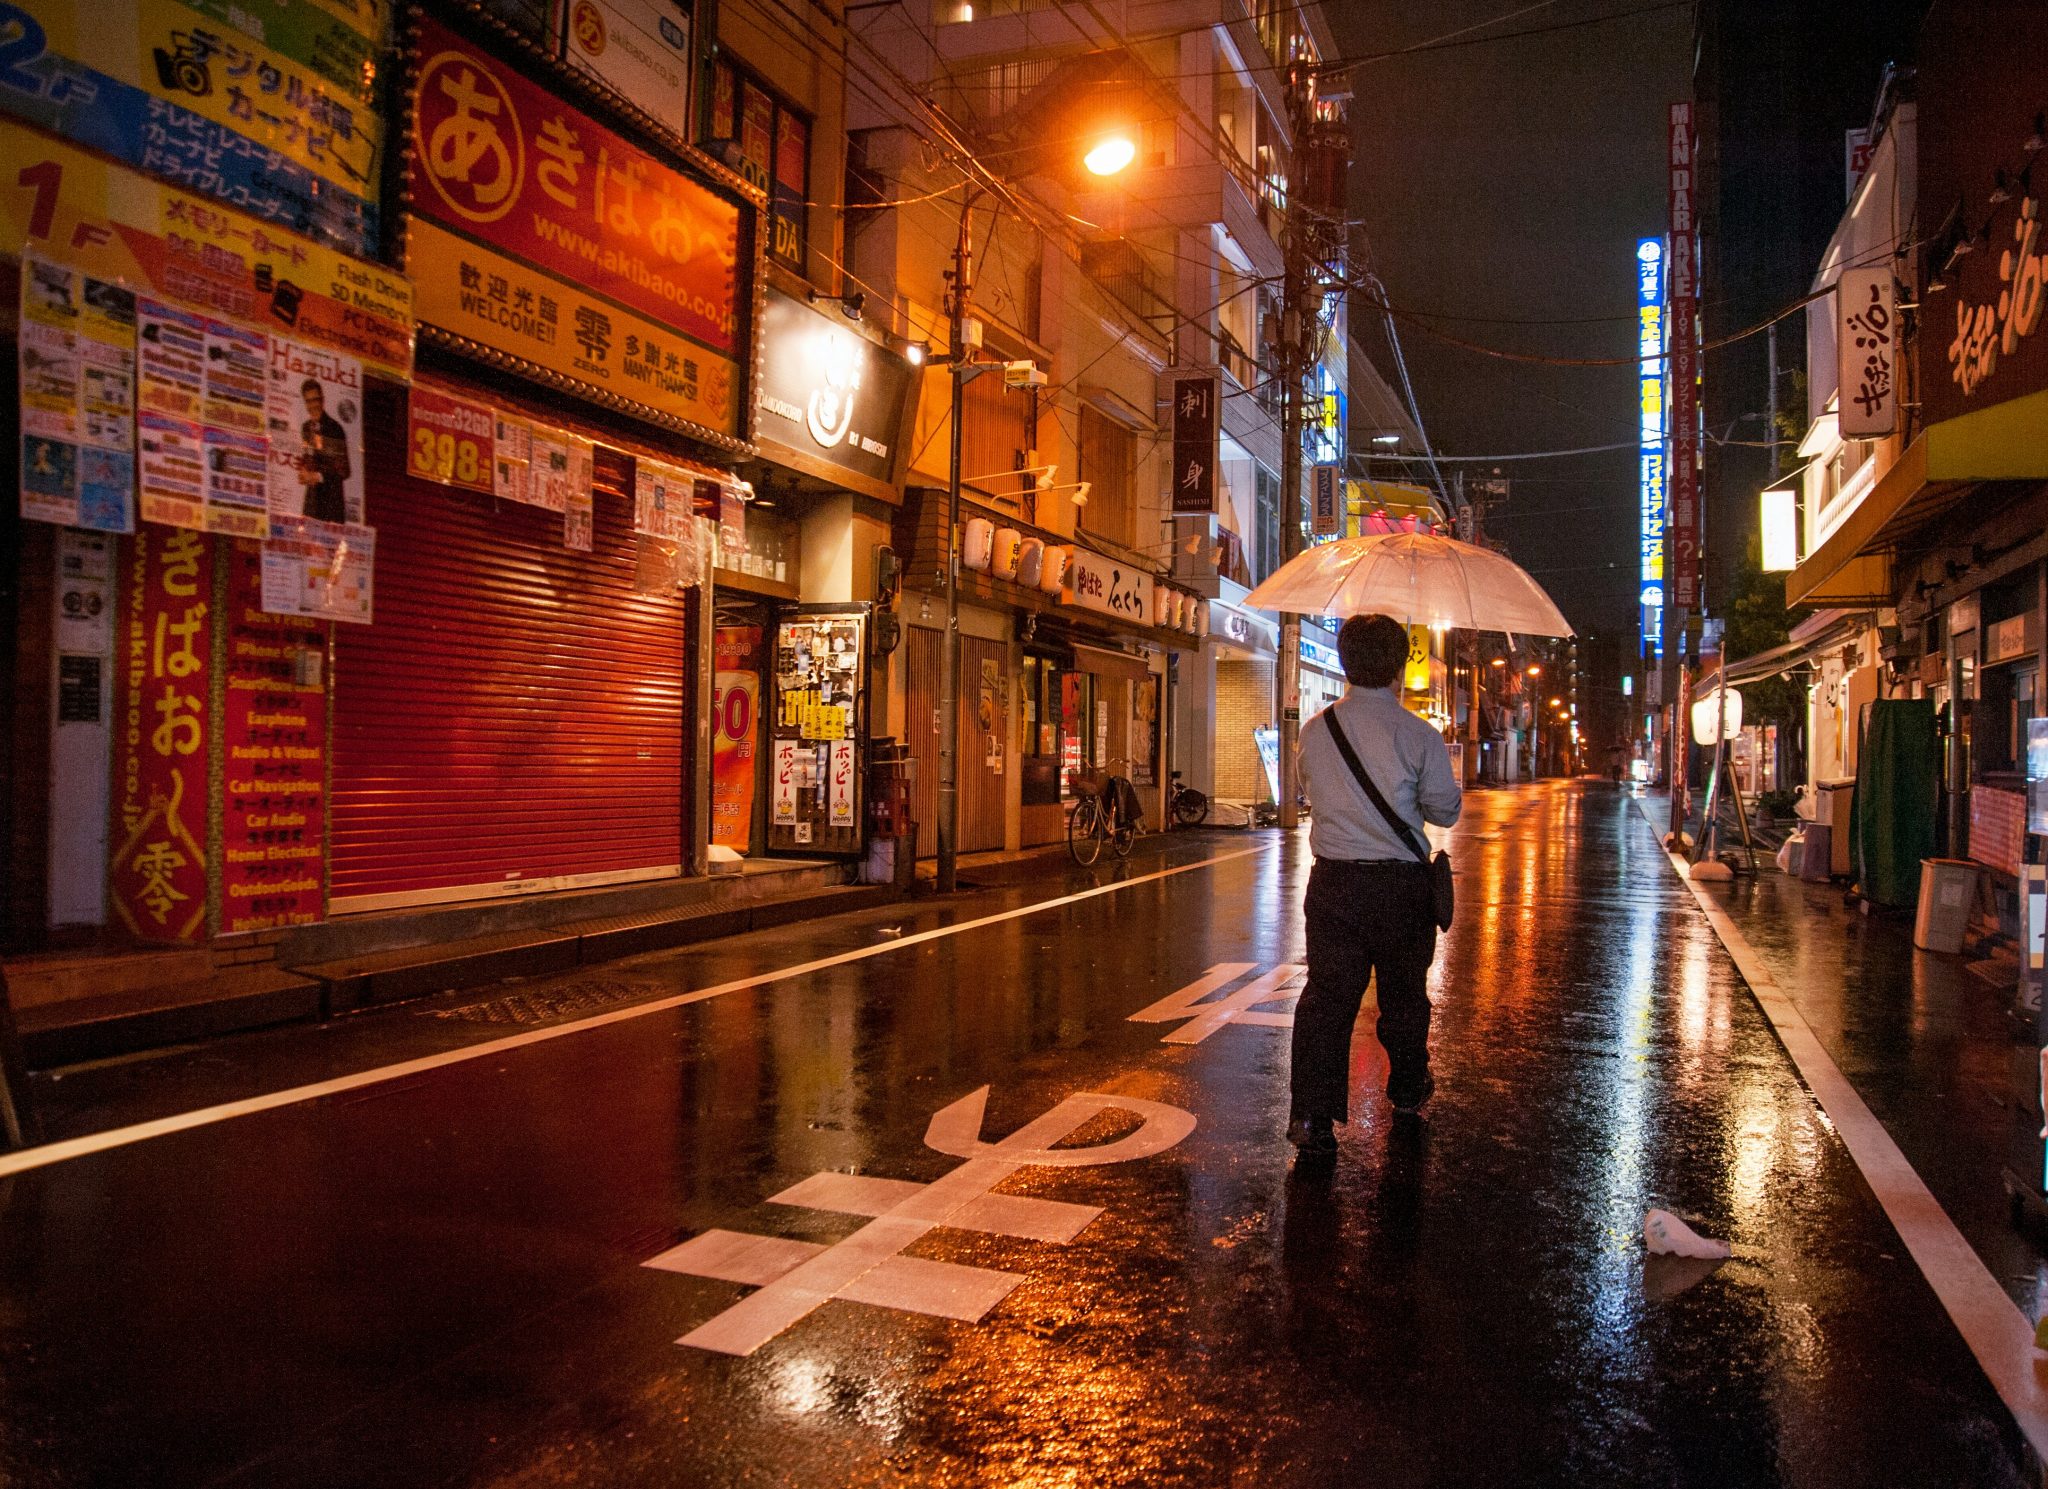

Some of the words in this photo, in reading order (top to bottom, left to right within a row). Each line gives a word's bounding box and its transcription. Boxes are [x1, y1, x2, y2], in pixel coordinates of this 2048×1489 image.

[1670, 103, 1692, 297] MANDARAKE
[533, 212, 739, 338] www.akibaoo.co.jp
[270, 339, 358, 390] Hazuki
[572, 358, 611, 380] ZERO
[414, 427, 478, 483] 398
[246, 711, 308, 728] Earphone
[229, 779, 252, 793] Car
[255, 780, 321, 797] Navigation
[835, 745, 851, 799] ホッピー
[246, 813, 268, 827] Car
[271, 812, 307, 826] Audio
